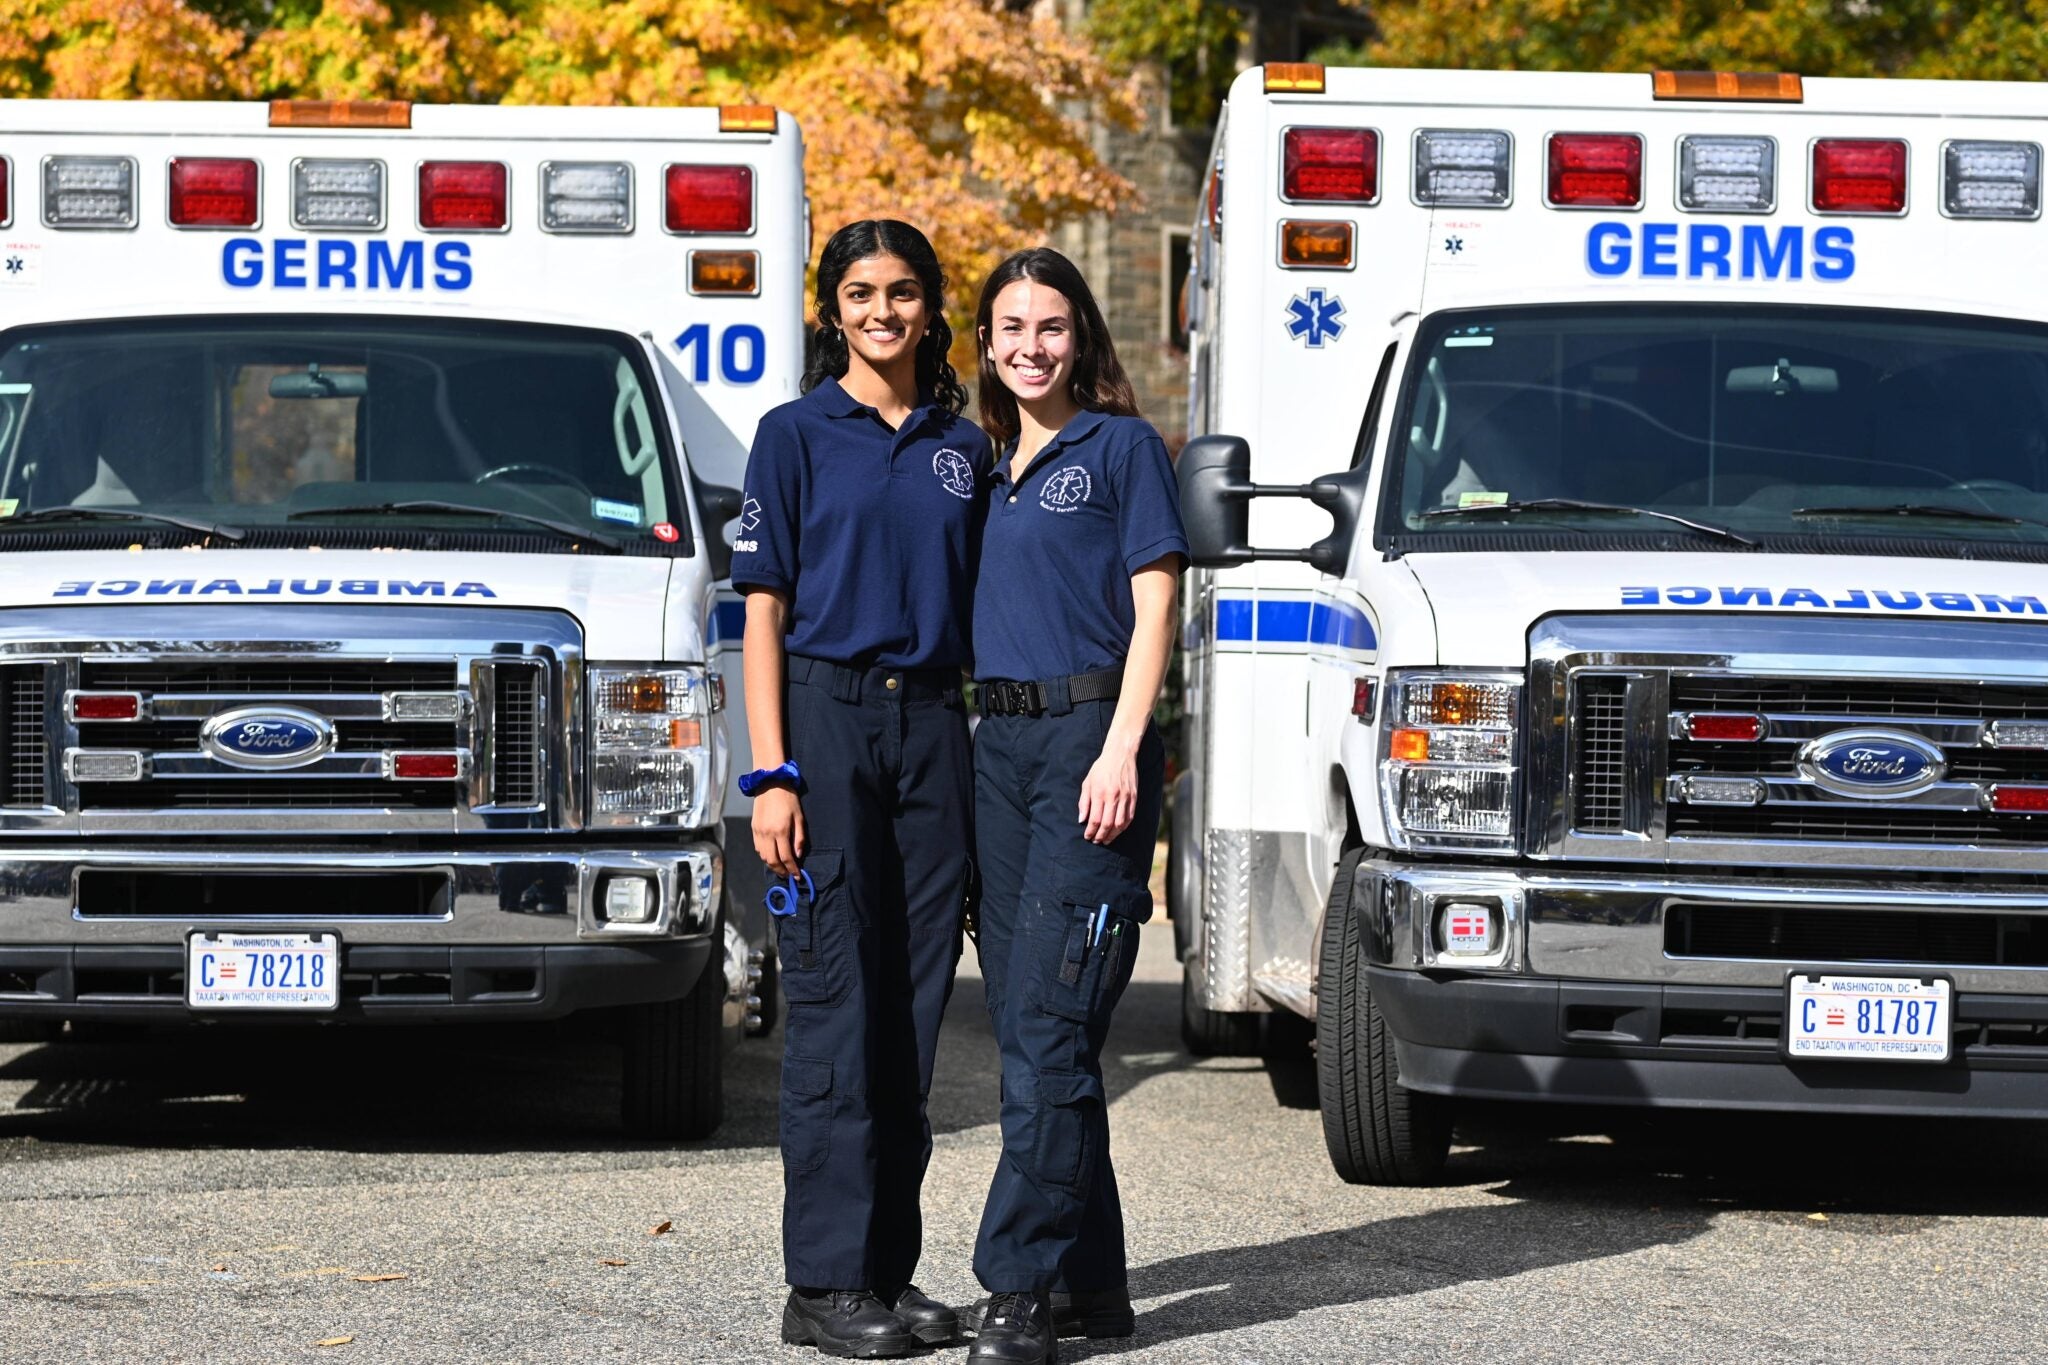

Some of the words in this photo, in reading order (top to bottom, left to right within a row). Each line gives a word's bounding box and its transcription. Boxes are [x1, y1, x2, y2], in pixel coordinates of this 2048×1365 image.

[222, 238, 472, 290] GERMS
[1586, 221, 1855, 280] GERMS
[674, 323, 766, 383] 10
[238, 722, 297, 747] Ford
[1843, 748, 1906, 775] Ford
[232, 939, 283, 949] WASHINGTON,
[284, 939, 295, 947] DC
[201, 953, 215, 988] C
[245, 953, 324, 988] 78218
[232, 992, 265, 1001] WITHOUT
[1832, 982, 1896, 993] WASHINGTON,
[1897, 983, 1910, 993] DC
[1802, 998, 1816, 1033] C
[1857, 999, 1937, 1036] 81787
[1796, 1040, 1811, 1050] END
[1812, 1040, 1846, 1051] TAXATION
[1847, 1041, 1880, 1053] WITHOUT
